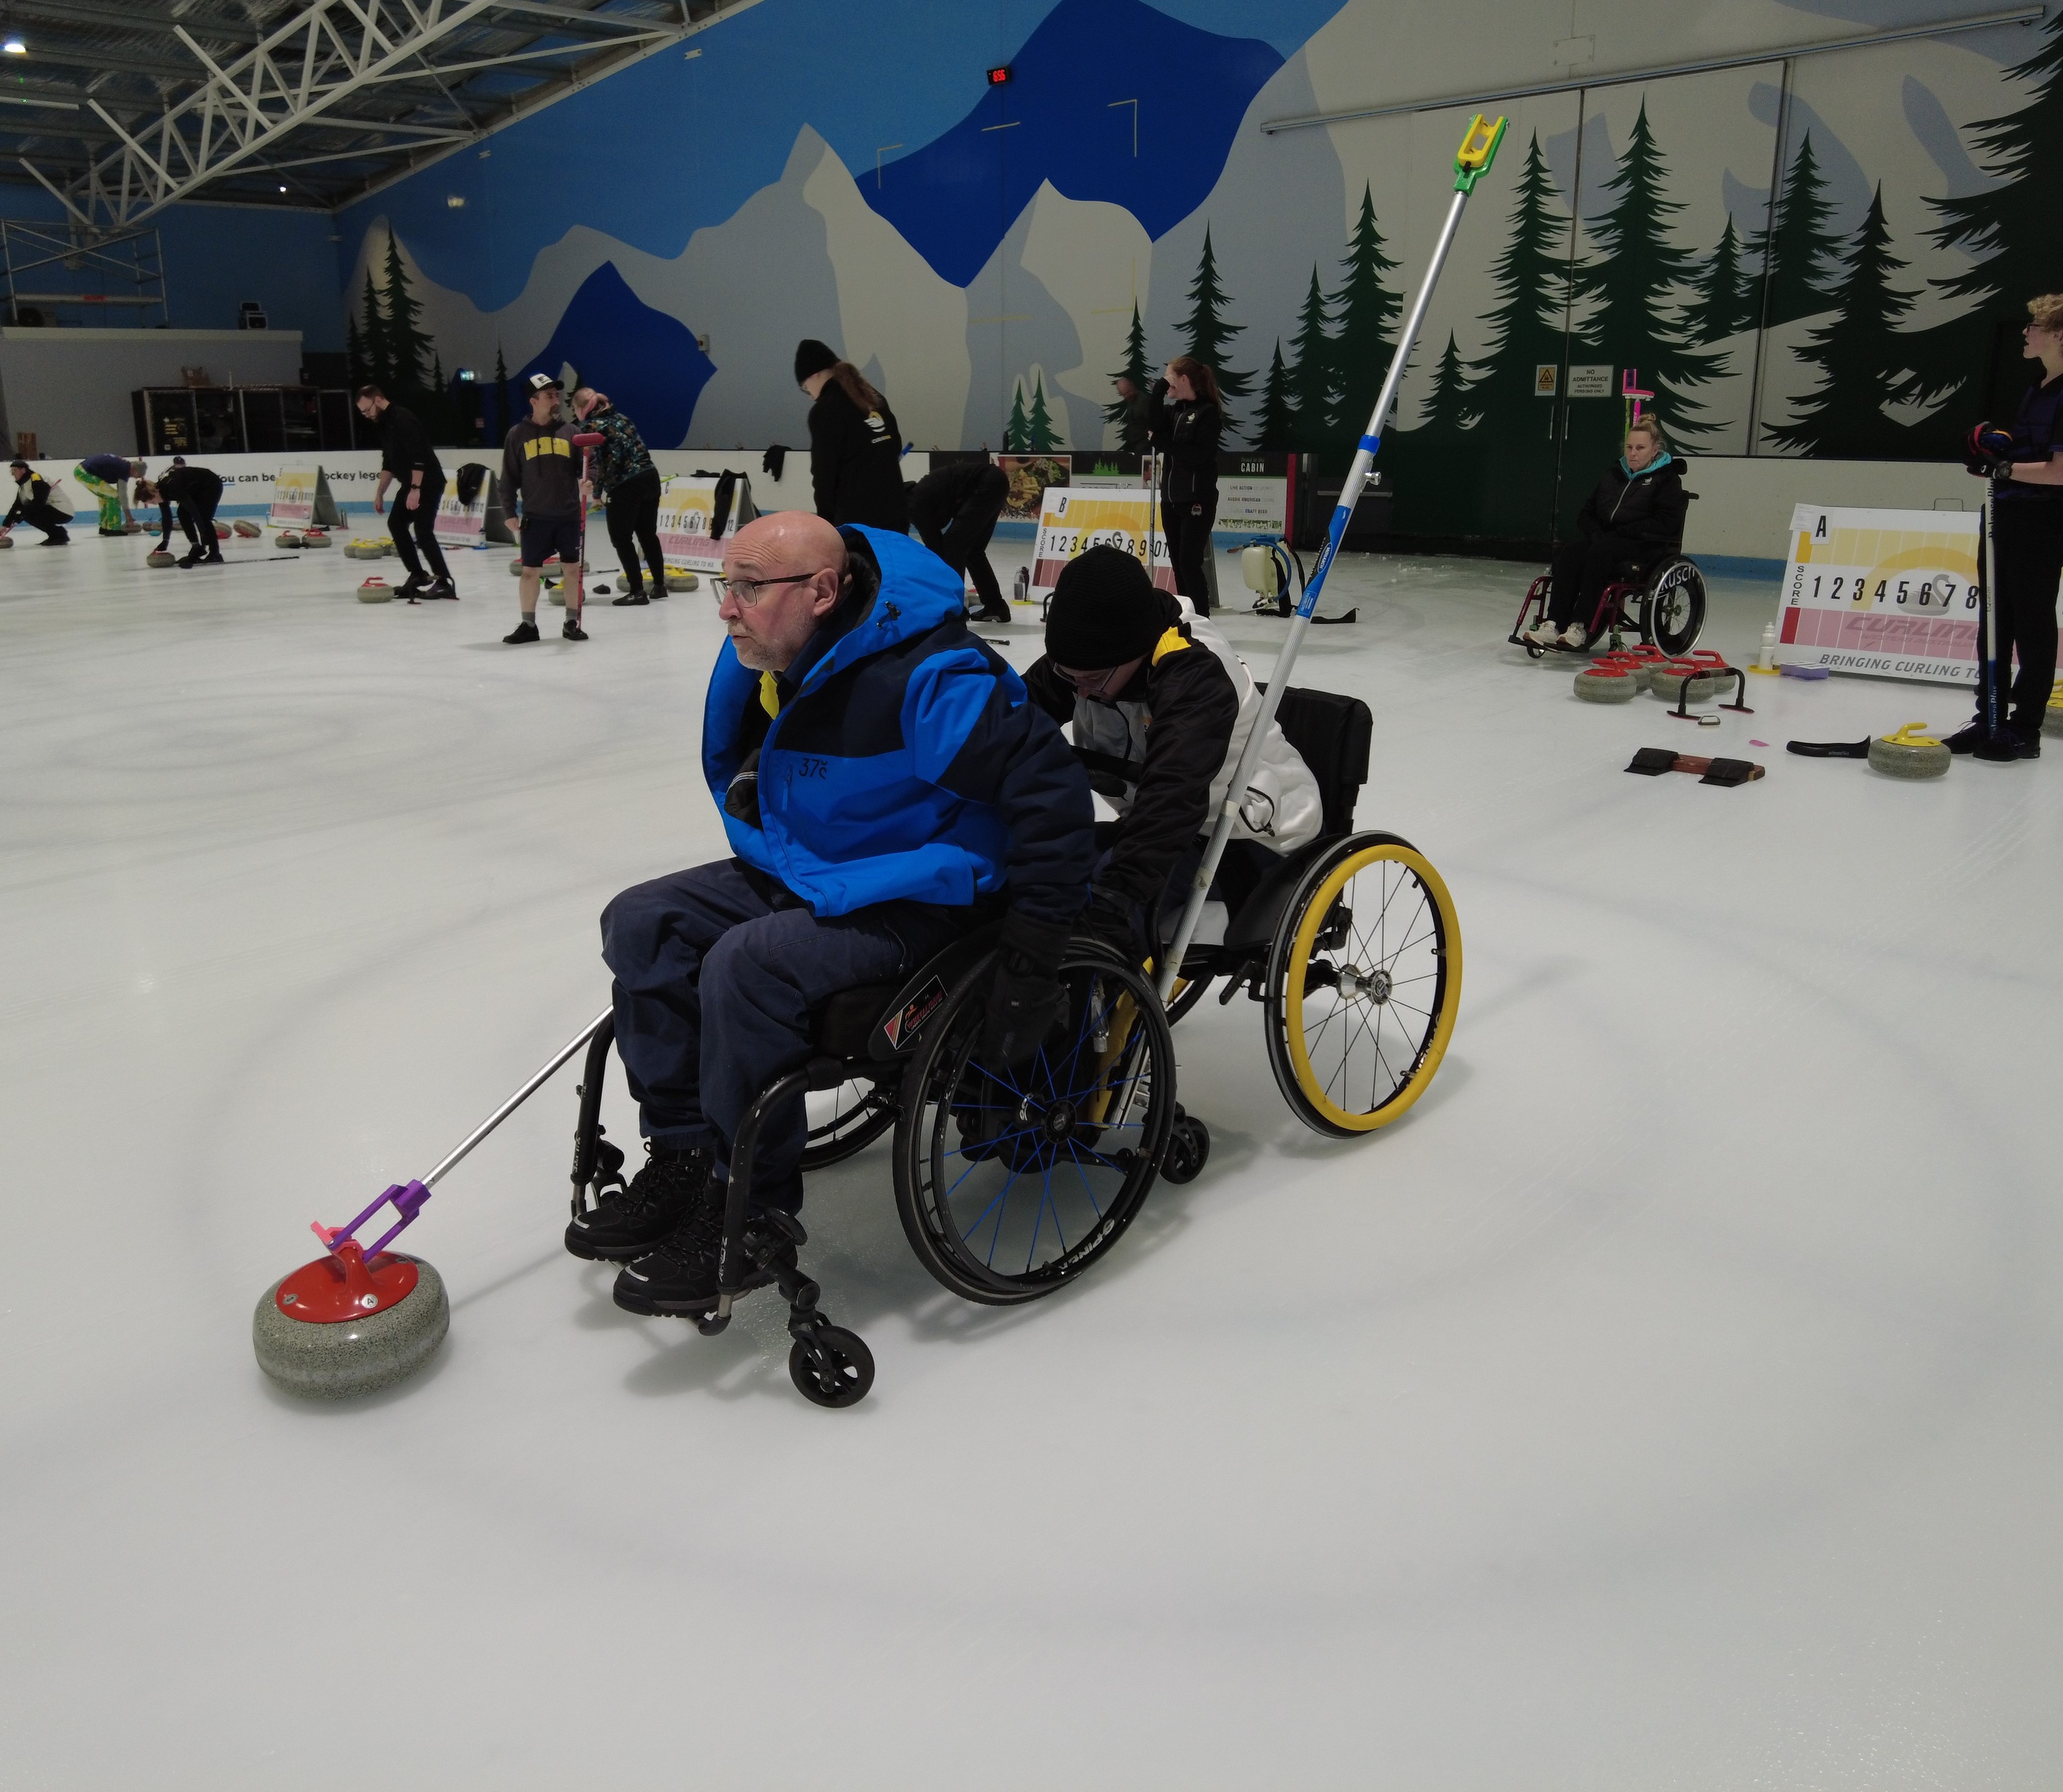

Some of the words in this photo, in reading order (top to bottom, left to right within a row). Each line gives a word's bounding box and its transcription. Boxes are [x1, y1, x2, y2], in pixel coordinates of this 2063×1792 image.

[262, 473, 275, 482] be
[324, 472, 356, 482] ockey
[1241, 463, 1264, 473] CABIN
[665, 482, 669, 494] C
[1059, 497, 1067, 513] B
[665, 515, 670, 527] 2
[671, 515, 675, 528] 3
[677, 516, 682, 528] 4
[683, 516, 688, 528] 5
[696, 517, 701, 530] 7
[702, 517, 706, 530] 8
[727, 519, 734, 531] 12
[1815, 515, 1827, 537] A
[1039, 528, 1048, 558] SCORE
[1050, 535, 1055, 551] 1
[1058, 536, 1067, 552] 2
[1070, 536, 1078, 552] 3
[1081, 537, 1088, 552] 4
[1126, 539, 1135, 555] 8
[1139, 540, 1147, 557] 9
[1791, 565, 1805, 606] SCORE
[1813, 576, 1822, 598] 1
[1831, 577, 1843, 600] 2
[1852, 578, 1865, 601] 3
[1874, 580, 1887, 603] 4
[1896, 581, 1910, 604] 5
[1919, 583, 1932, 606] 6
[1942, 584, 1957, 607] 7
[1965, 585, 1979, 610] 8
[1819, 653, 1890, 671] BRINGING
[1895, 661, 1961, 678] CURLING
